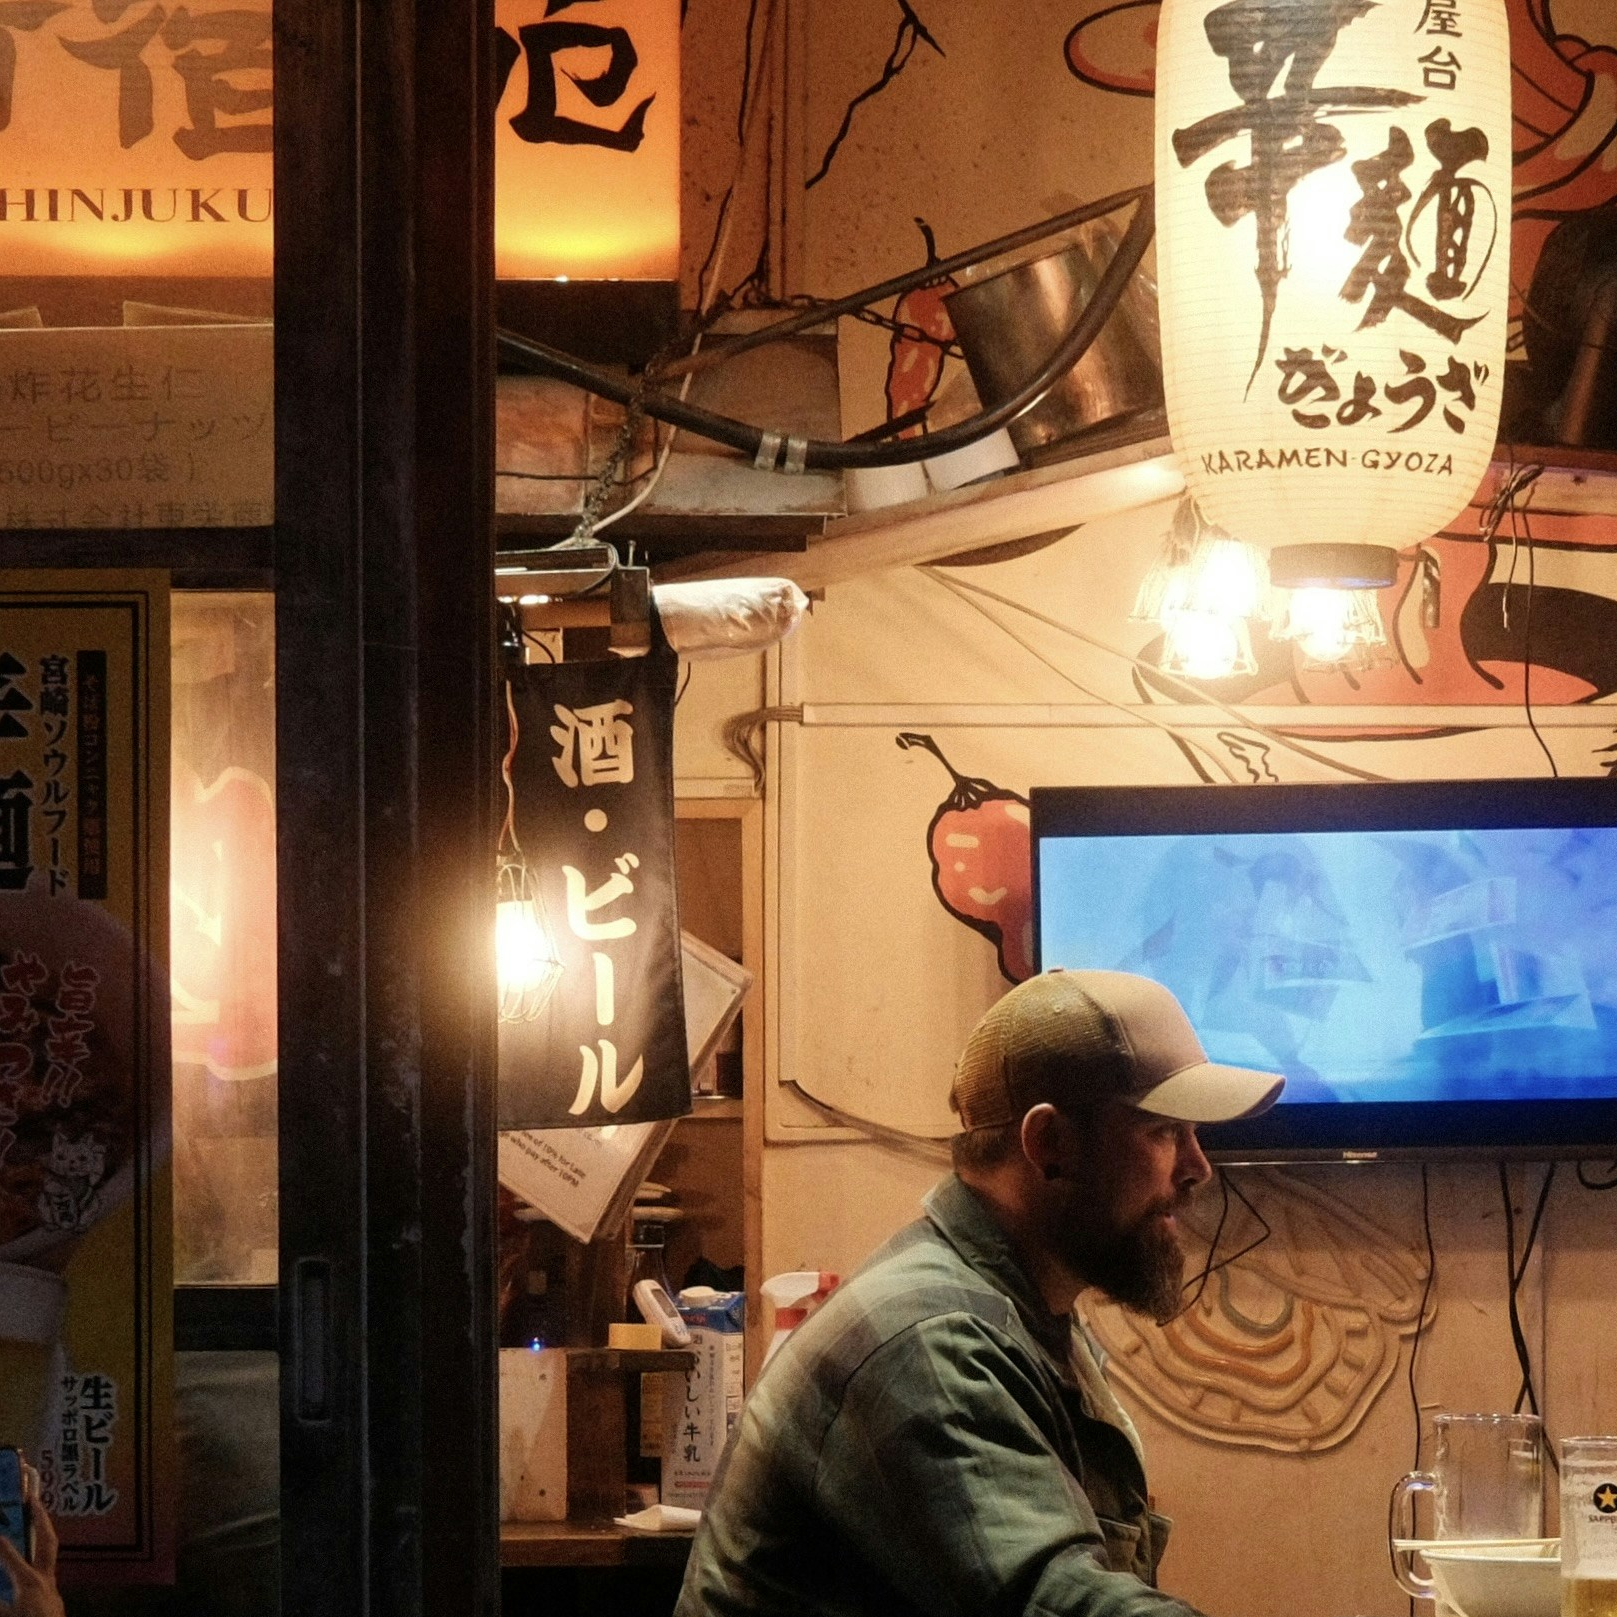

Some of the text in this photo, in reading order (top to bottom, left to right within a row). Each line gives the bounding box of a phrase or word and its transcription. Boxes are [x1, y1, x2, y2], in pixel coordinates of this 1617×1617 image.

[1274, 344, 1490, 435] ぎょうざ
[1201, 447, 1456, 479] KARAMEN-GYOZA
[81, 1375, 115, 1512] 生ビール
